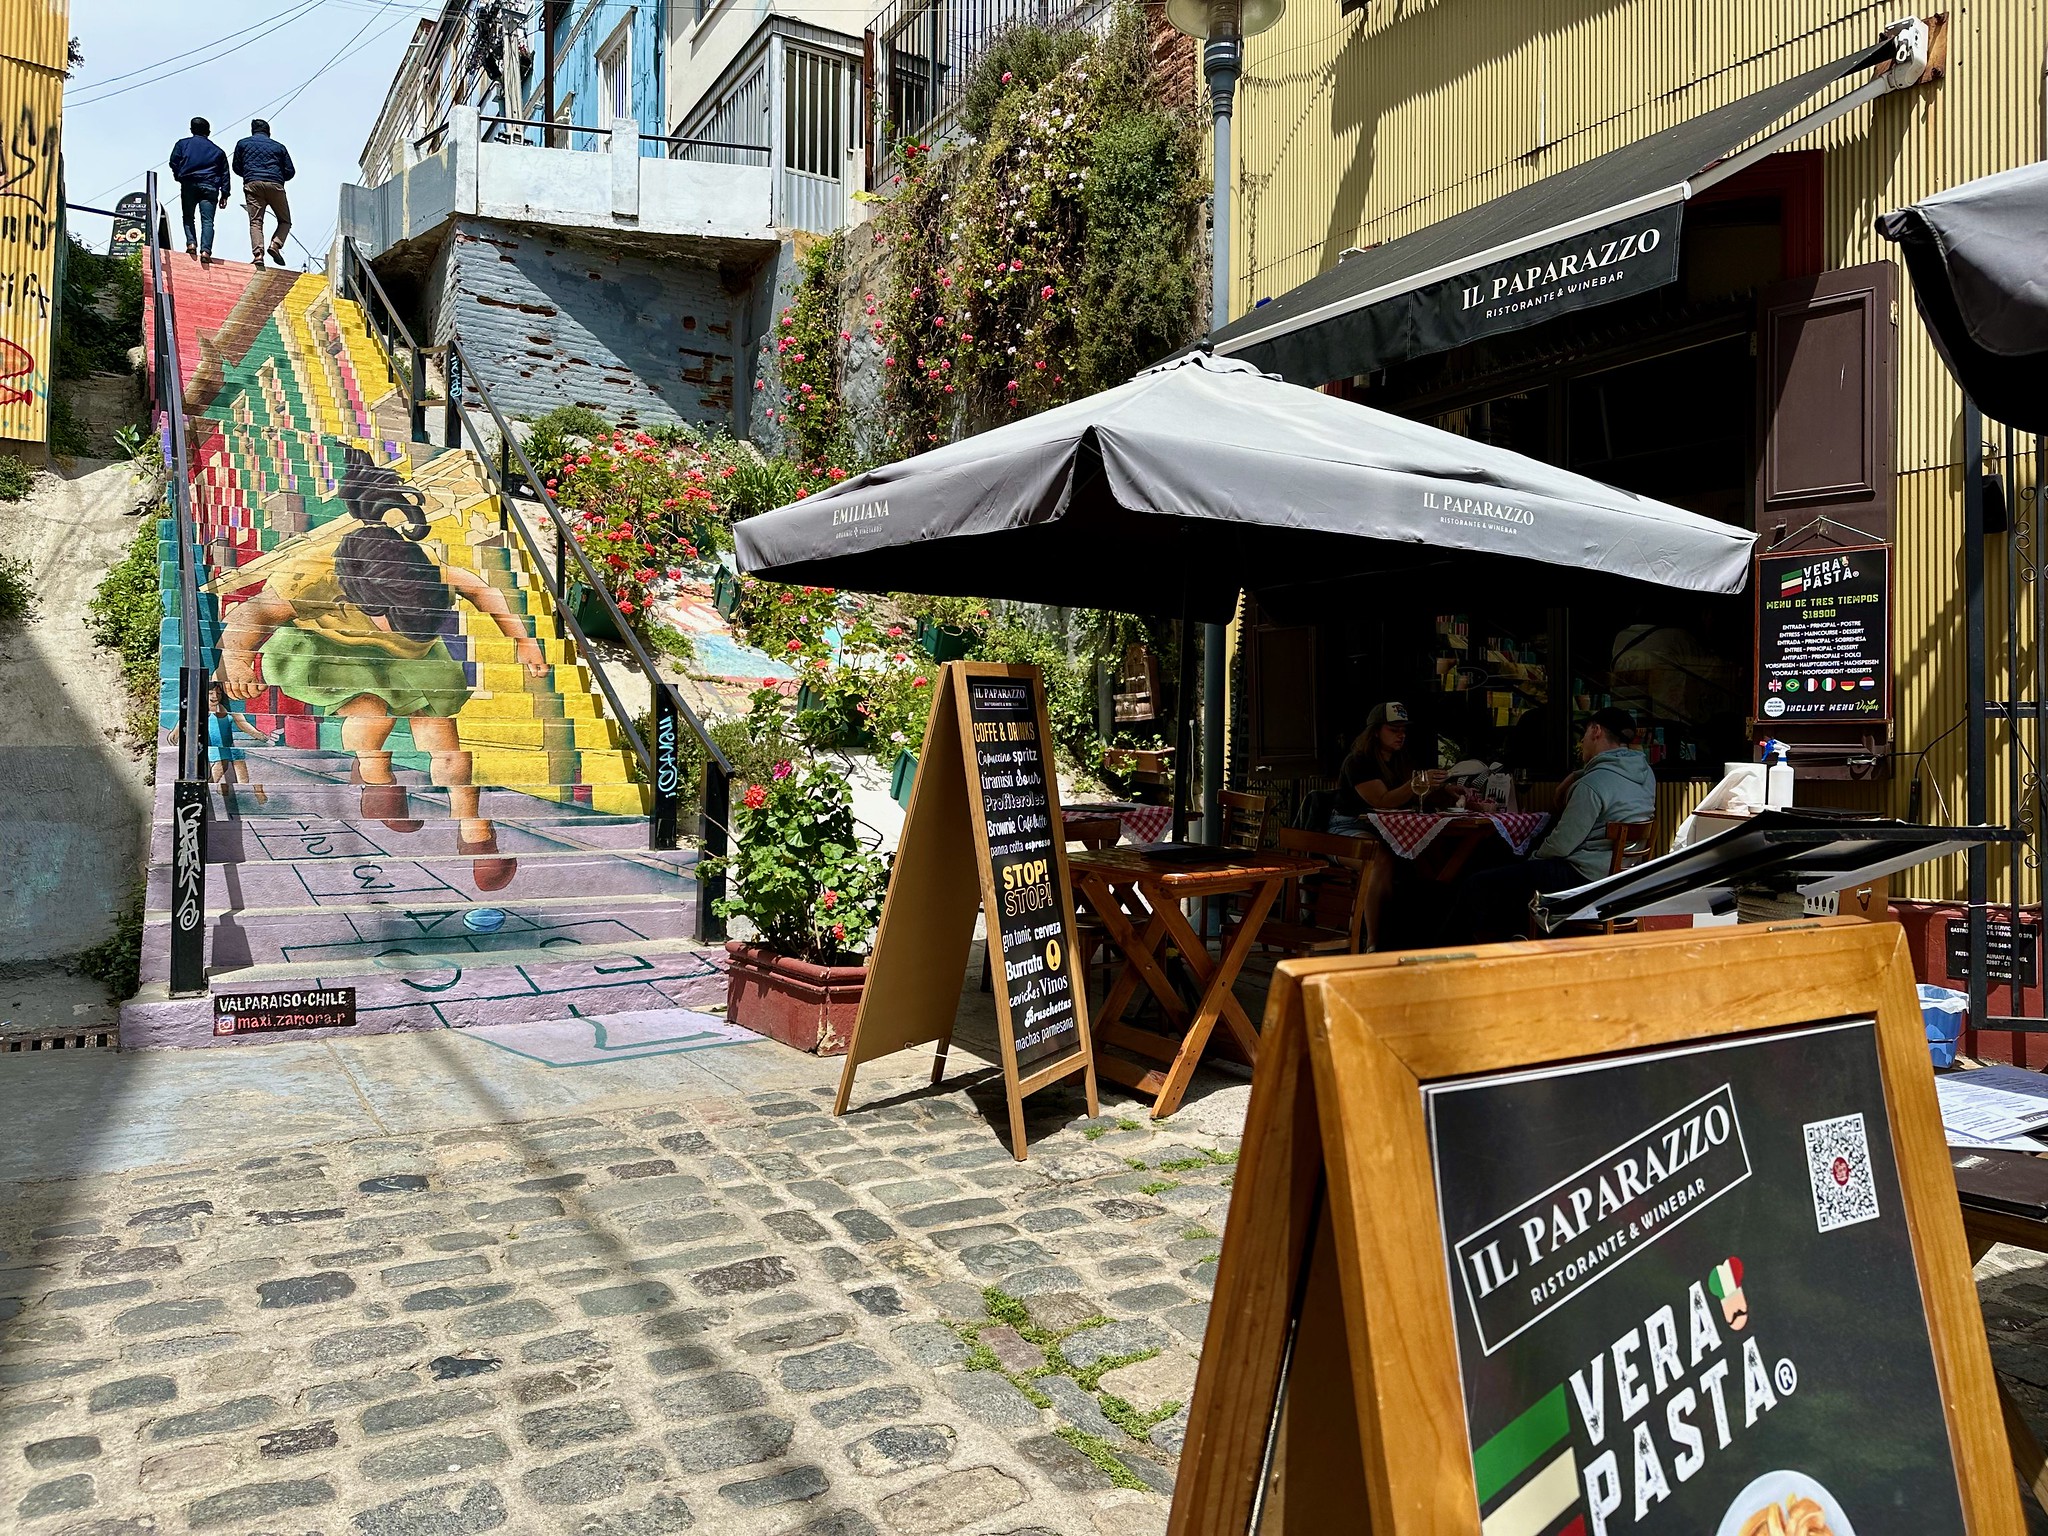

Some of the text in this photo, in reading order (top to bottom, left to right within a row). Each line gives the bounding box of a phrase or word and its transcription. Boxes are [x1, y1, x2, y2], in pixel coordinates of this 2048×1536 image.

[1462, 228, 1660, 311] IL PAPARAZZO
[1486, 271, 1624, 319] RISTORANTE & WINEBAR
[832, 500, 889, 526] EMILIANA
[1423, 492, 1534, 525] IL PAPARAZZO
[1440, 517, 1480, 528] RISTORANTE
[1488, 524, 1517, 535] WINEBAR
[1803, 558, 1840, 578] VERA
[1766, 594, 1879, 609] MENU DE TRES TIEMPOS
[1802, 609, 1836, 619] $18900
[975, 688, 1026, 700] IL PAPARAZZO
[1786, 704, 1825, 712] INCLUYE
[1829, 703, 1855, 711] MENU
[1855, 699, 1879, 713] Vegan
[974, 722, 1035, 743] COFFE & DRINKS
[1012, 747, 1037, 766] spritz
[1016, 769, 1040, 787] Sour
[984, 790, 1045, 812] Profiteroles
[987, 817, 1016, 838] Brownie
[990, 839, 1051, 860] panna cotta espresso
[1002, 859, 1049, 890] STOP!
[1004, 882, 1053, 917] STOP!
[1002, 921, 1061, 953] gin tonic cerveza
[1005, 954, 1044, 981] Burrata
[1009, 975, 1068, 1008] ceviches Vinos
[237, 1012, 346, 1030] maxi.zamora.r
[1025, 999, 1072, 1028] Bruschettas
[1015, 1017, 1074, 1052] machas parmesana
[1468, 1104, 1731, 1300] IL PAPARAZZO
[1530, 1177, 1707, 1306] RISTORANTE & WINEBAR
[1568, 1280, 1722, 1446] VERA
